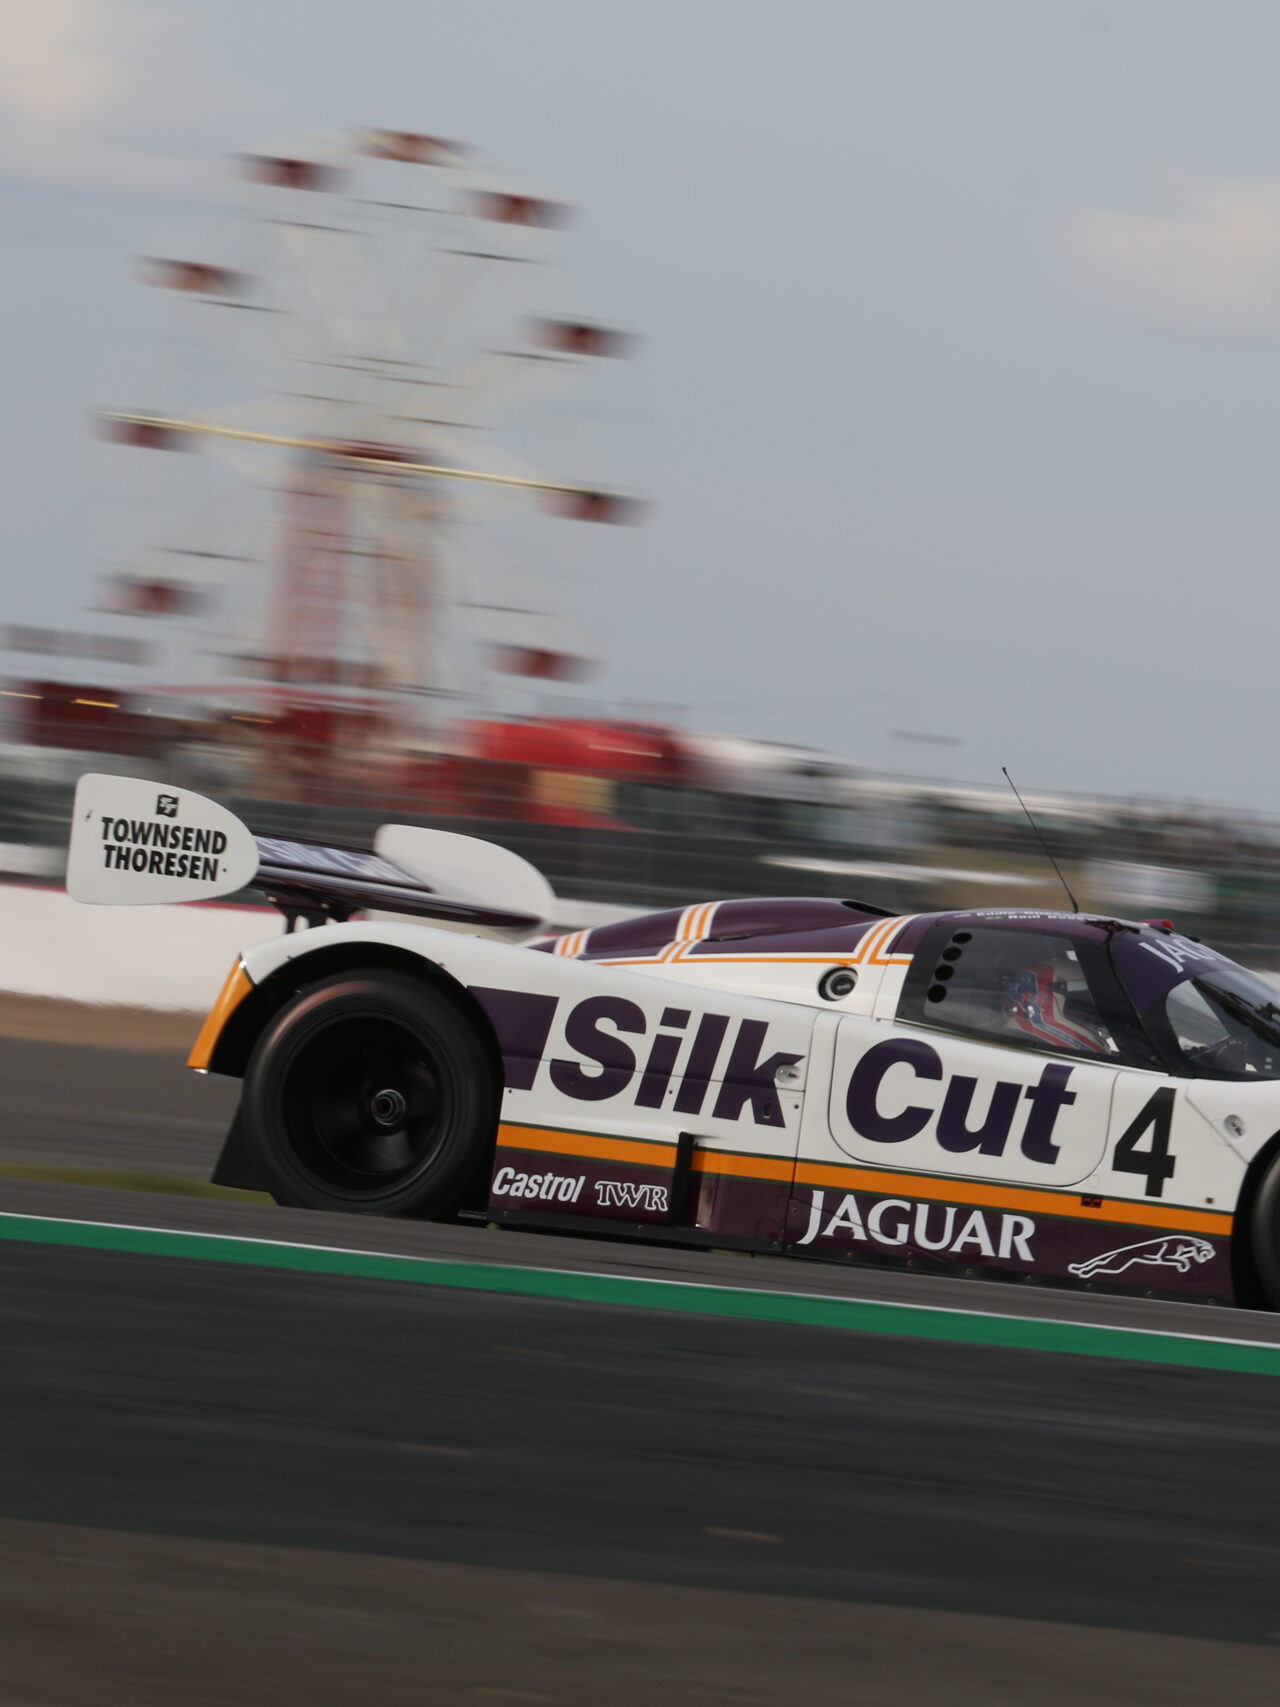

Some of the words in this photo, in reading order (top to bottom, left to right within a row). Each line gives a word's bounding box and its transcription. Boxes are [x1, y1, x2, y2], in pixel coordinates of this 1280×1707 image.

[102, 816, 227, 854] TOWNSEND
[104, 844, 218, 882] THORESEN
[549, 995, 804, 1128] Silk
[845, 1038, 1076, 1164] Cut
[1111, 1086, 1177, 1197] 4
[492, 1166, 586, 1203] Castrol
[594, 1180, 668, 1212] TWR
[797, 1190, 1035, 1262] JAGUAR
